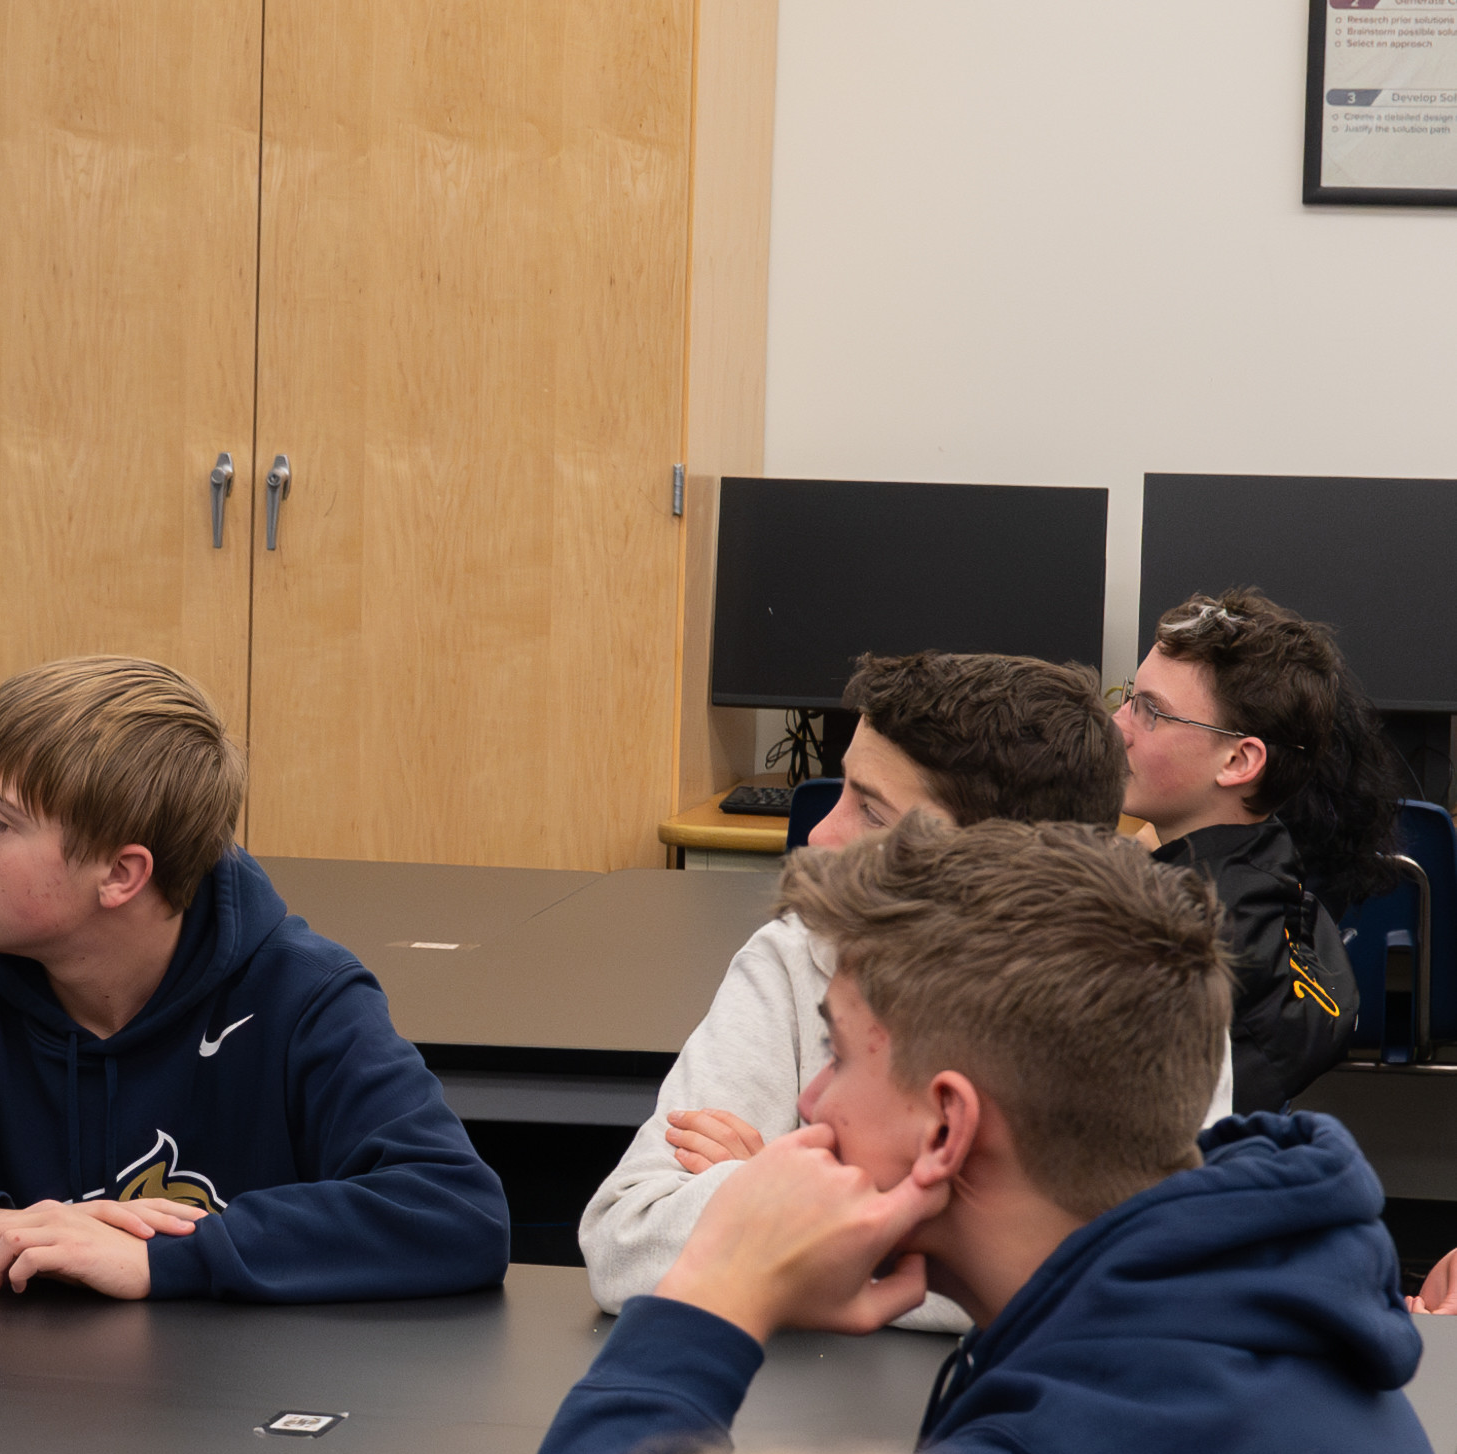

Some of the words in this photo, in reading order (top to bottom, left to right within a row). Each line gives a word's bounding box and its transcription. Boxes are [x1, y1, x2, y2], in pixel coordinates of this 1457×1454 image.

[1391, 16, 1411, 25] prior
[1414, 16, 1454, 24] solutions
[1347, 28, 1395, 36] Brainstorm
[1398, 28, 1434, 37] possible
[1390, 40, 1432, 49] approach
[1347, 92, 1356, 104] 3
[1391, 93, 1437, 103] Develop
[1440, 93, 1457, 102] Sol
[1344, 113, 1375, 121] Create
[1384, 113, 1420, 121] detailed
[1423, 113, 1453, 122] design
[1344, 125, 1372, 134] Justify
[1375, 125, 1389, 133] the
[1392, 125, 1428, 133] solution
[1430, 125, 1451, 134] path
